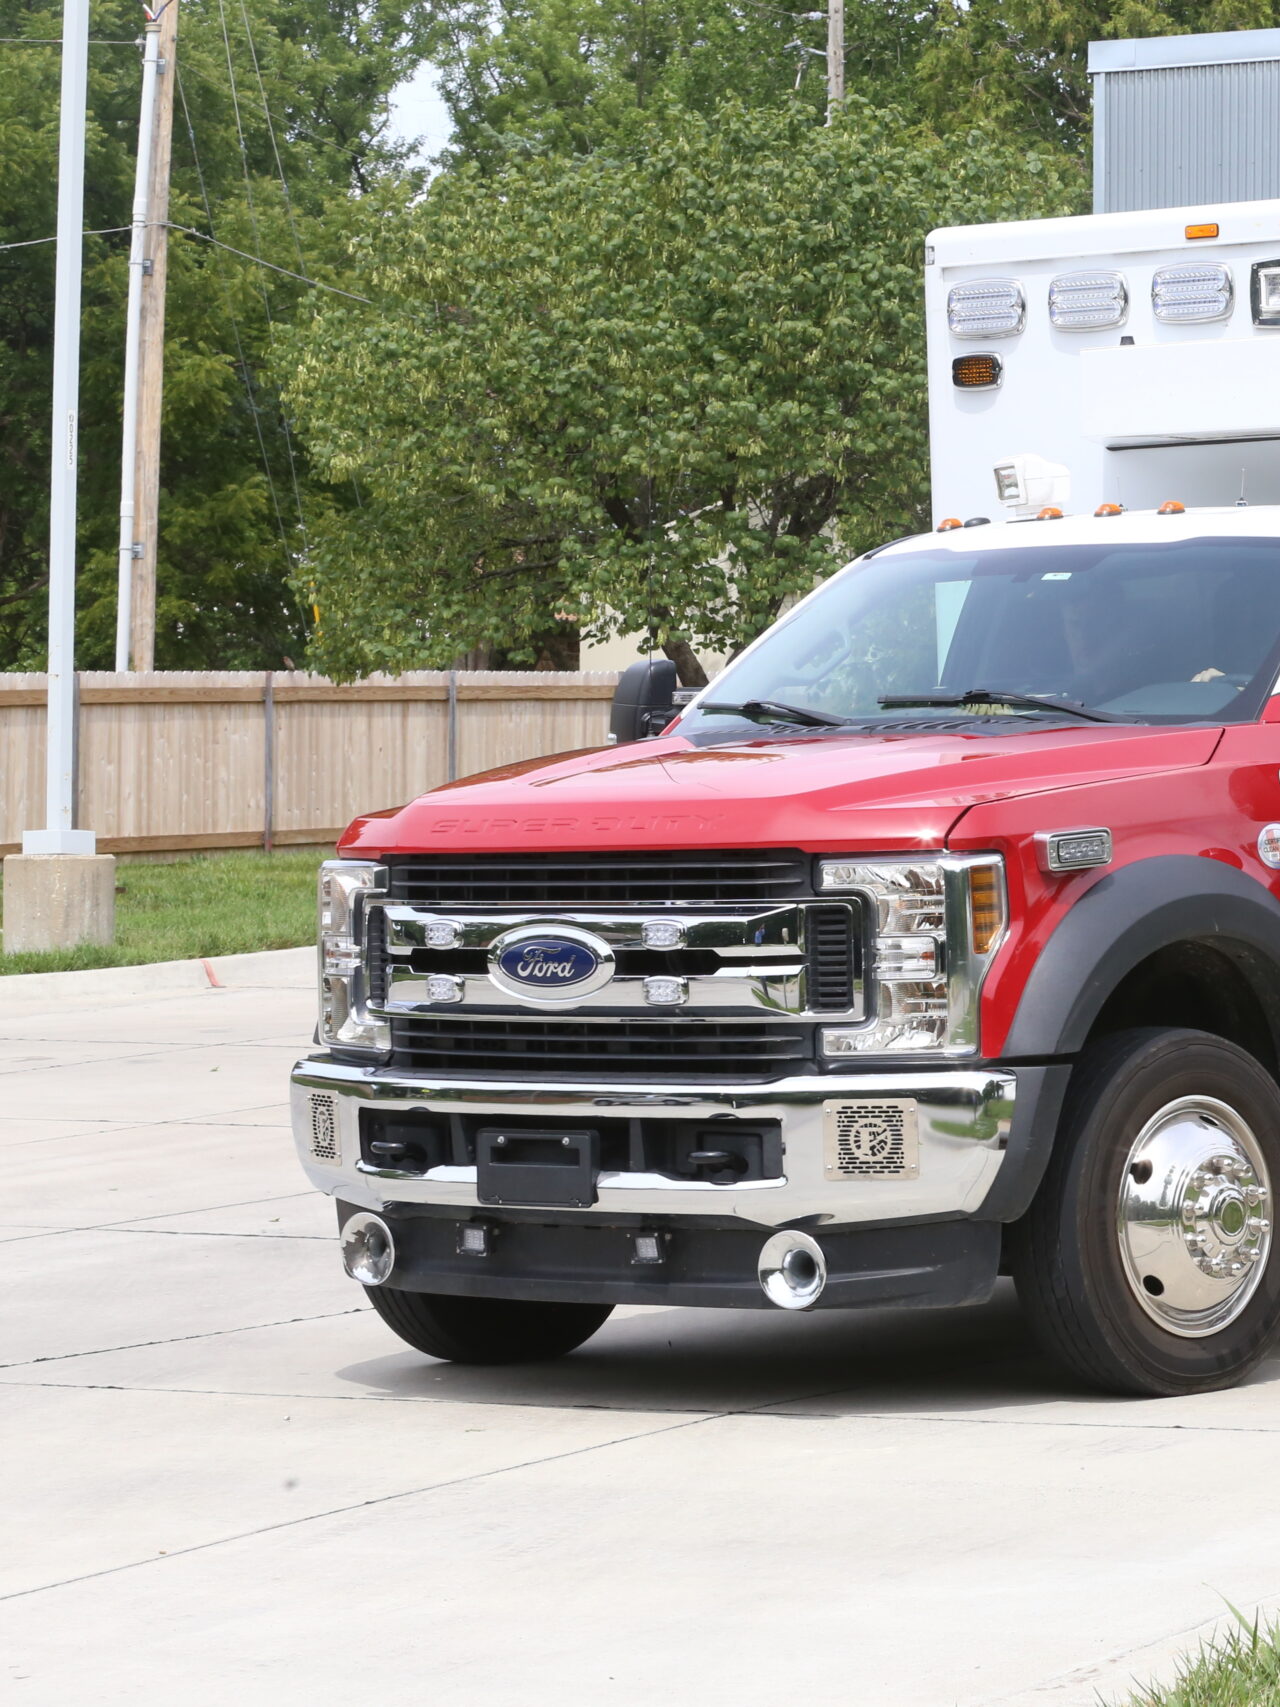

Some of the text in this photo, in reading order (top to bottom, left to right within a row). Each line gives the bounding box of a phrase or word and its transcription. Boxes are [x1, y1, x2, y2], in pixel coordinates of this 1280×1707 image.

[430, 814, 726, 834] SUPER DUTY
[517, 946, 577, 977] Ford
